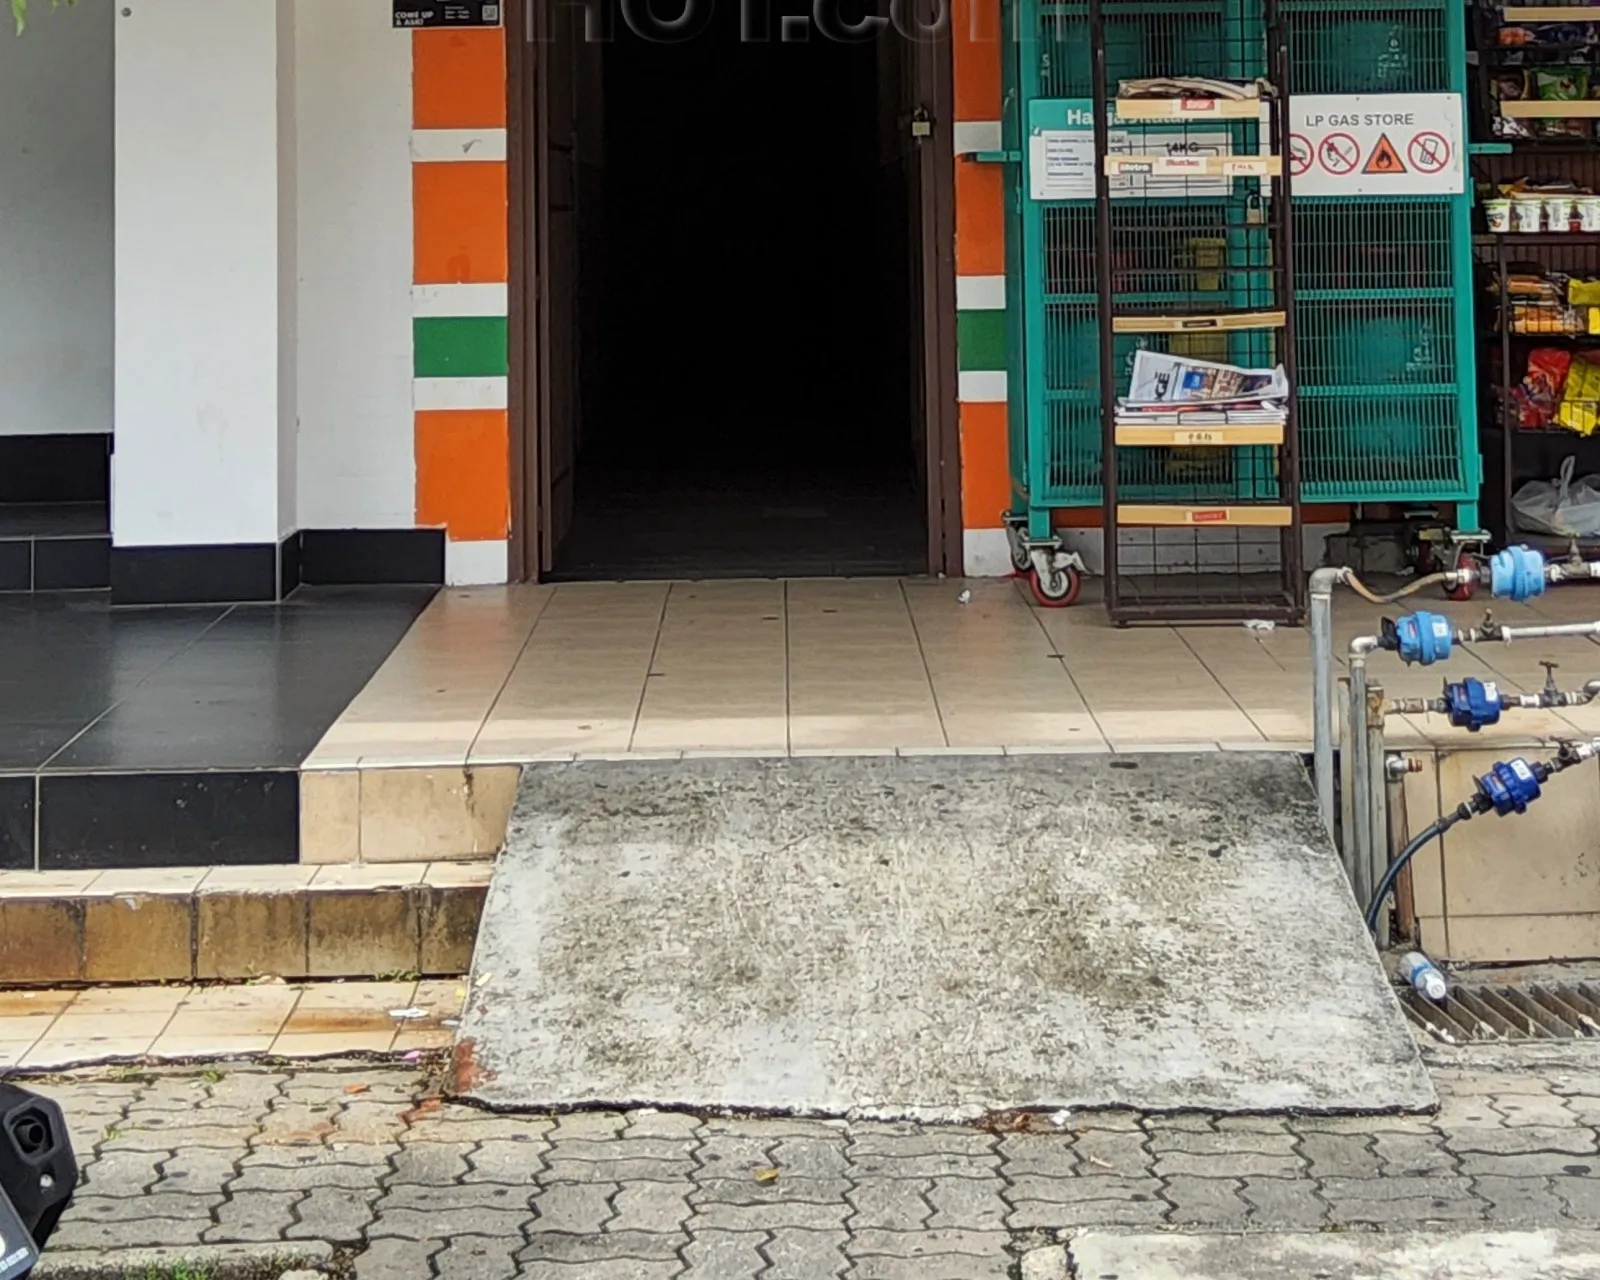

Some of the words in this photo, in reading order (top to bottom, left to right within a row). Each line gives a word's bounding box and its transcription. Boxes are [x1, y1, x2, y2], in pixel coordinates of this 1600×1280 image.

[1306, 114, 1325, 128] LP
[1328, 113, 1361, 127] GAS
[1364, 112, 1414, 127] STORE
